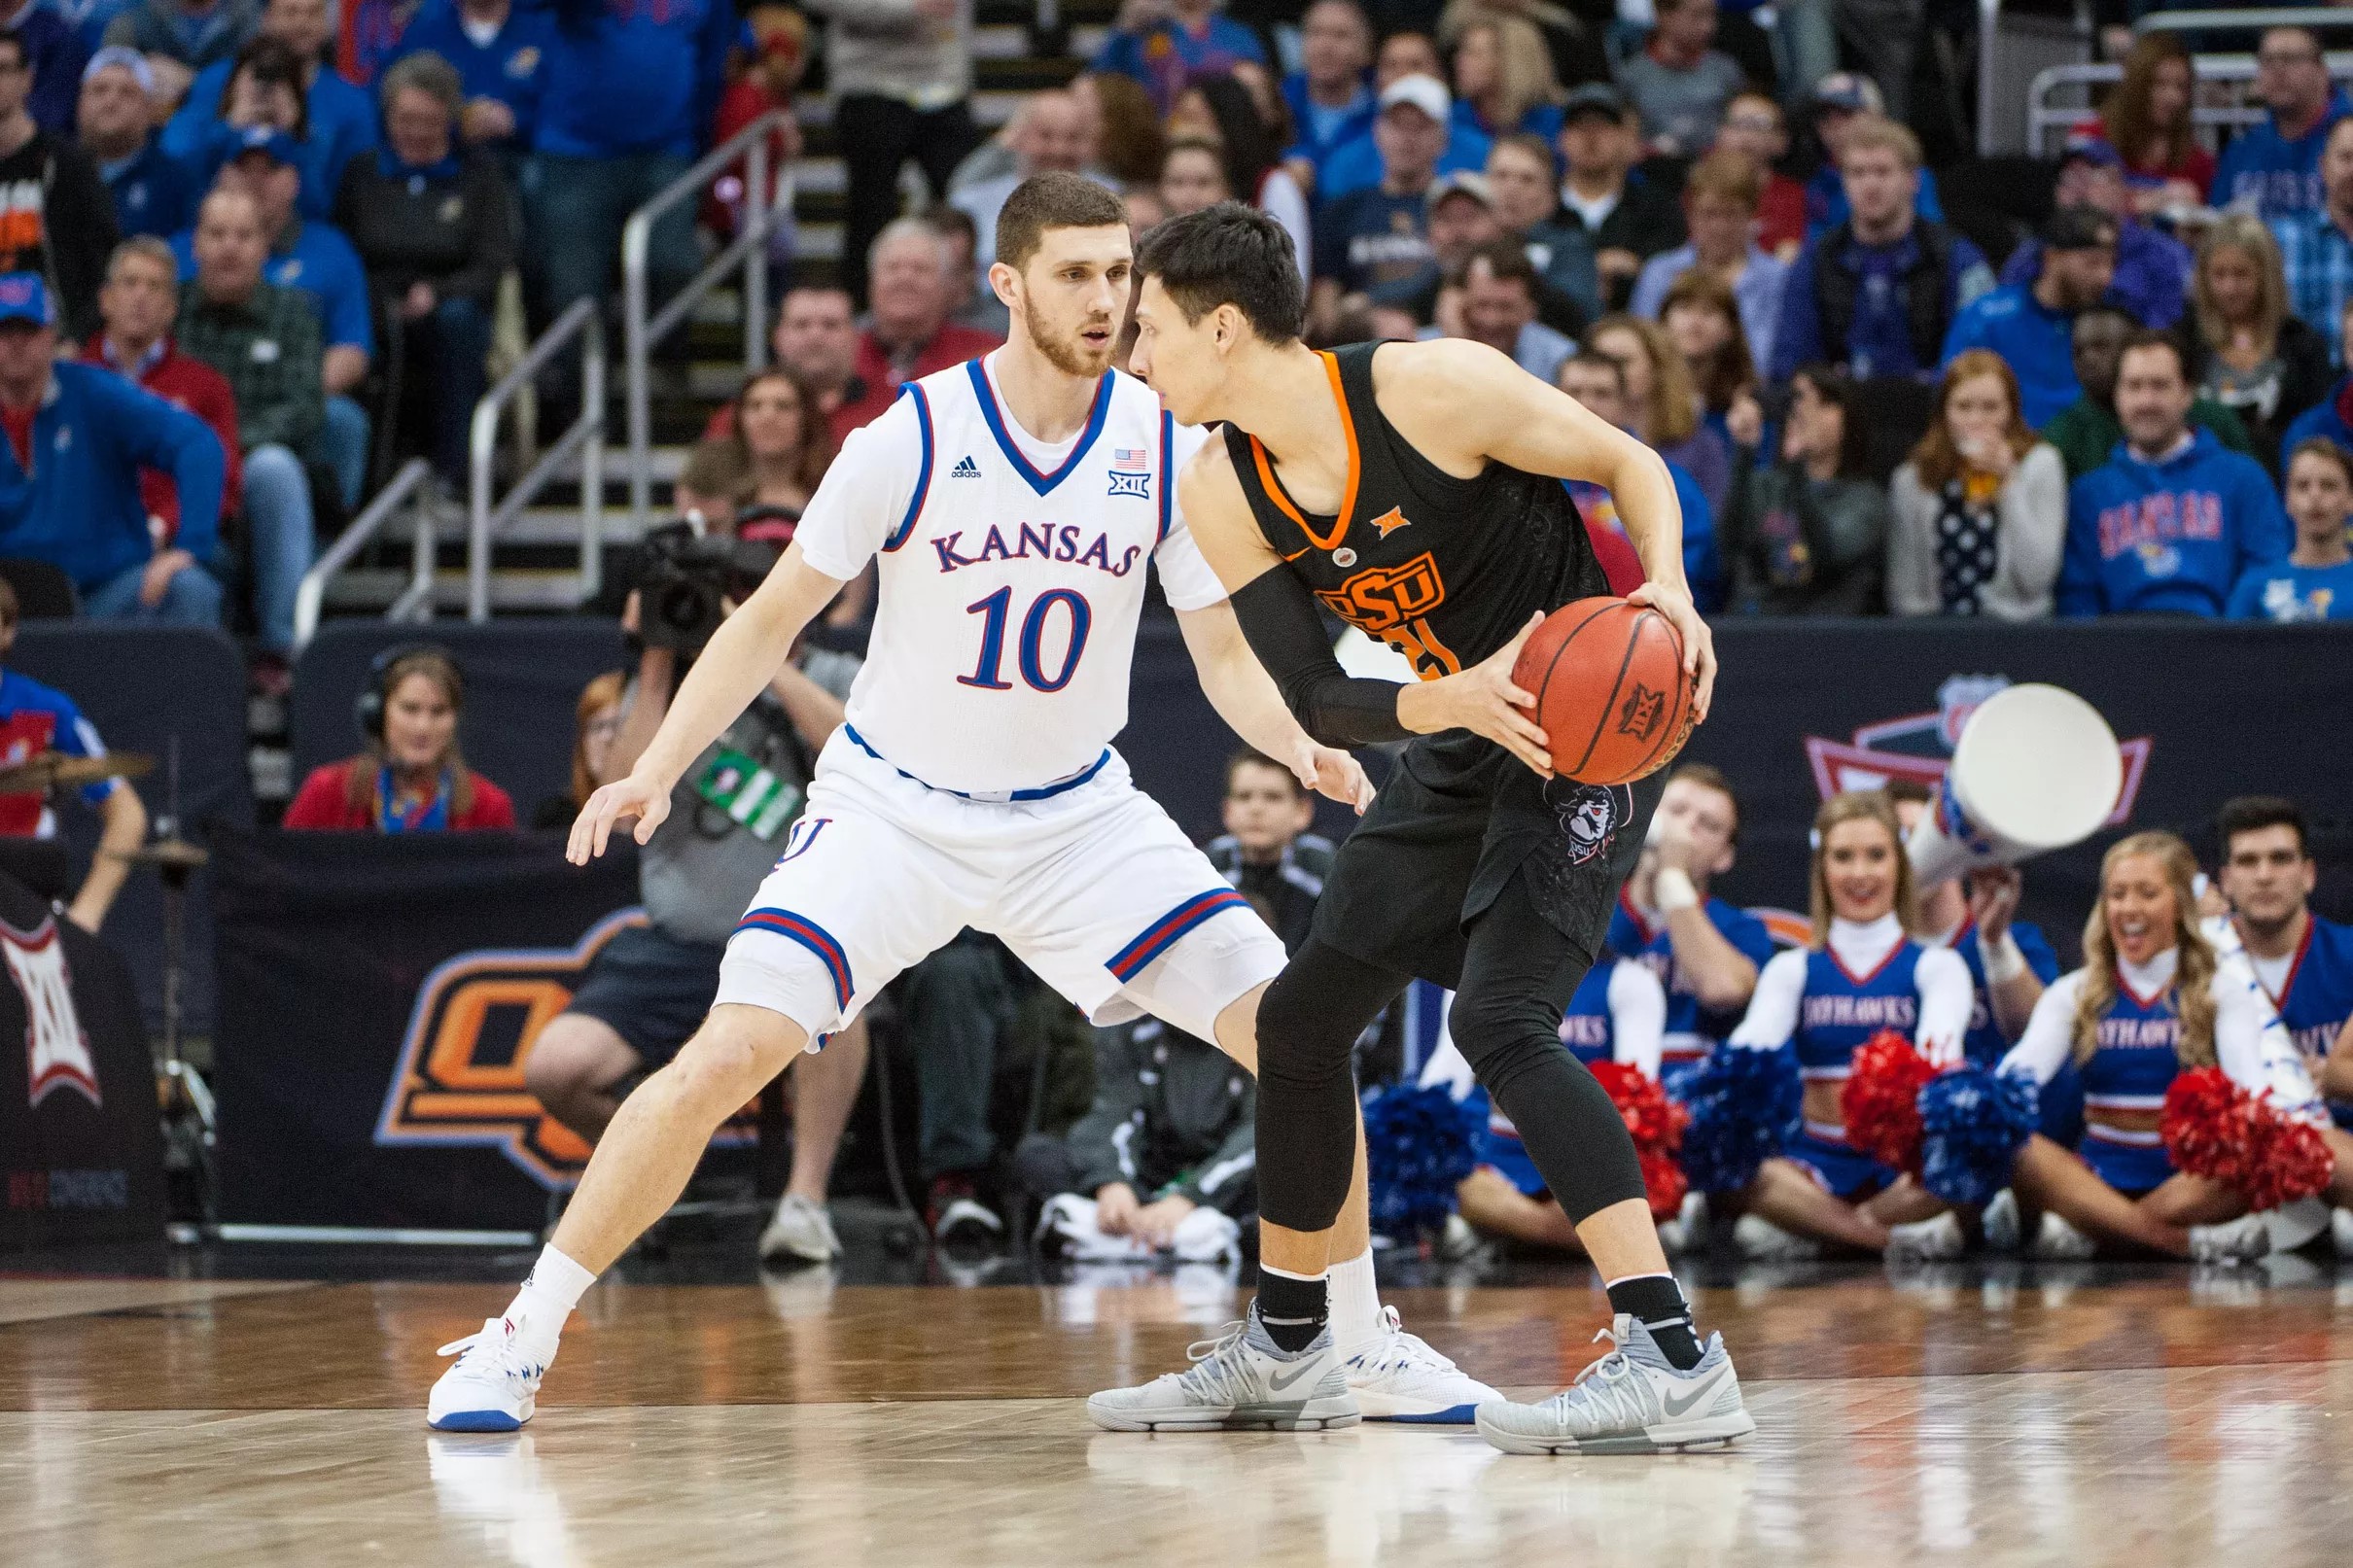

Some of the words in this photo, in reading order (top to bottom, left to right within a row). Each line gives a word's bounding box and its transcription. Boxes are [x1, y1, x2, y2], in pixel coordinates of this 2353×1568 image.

[951, 470, 982, 478] adidas
[931, 522, 1141, 577] KANSAS
[1316, 552, 1445, 635] OSU
[957, 585, 1092, 693] 10
[1571, 843, 1590, 855] OSU
